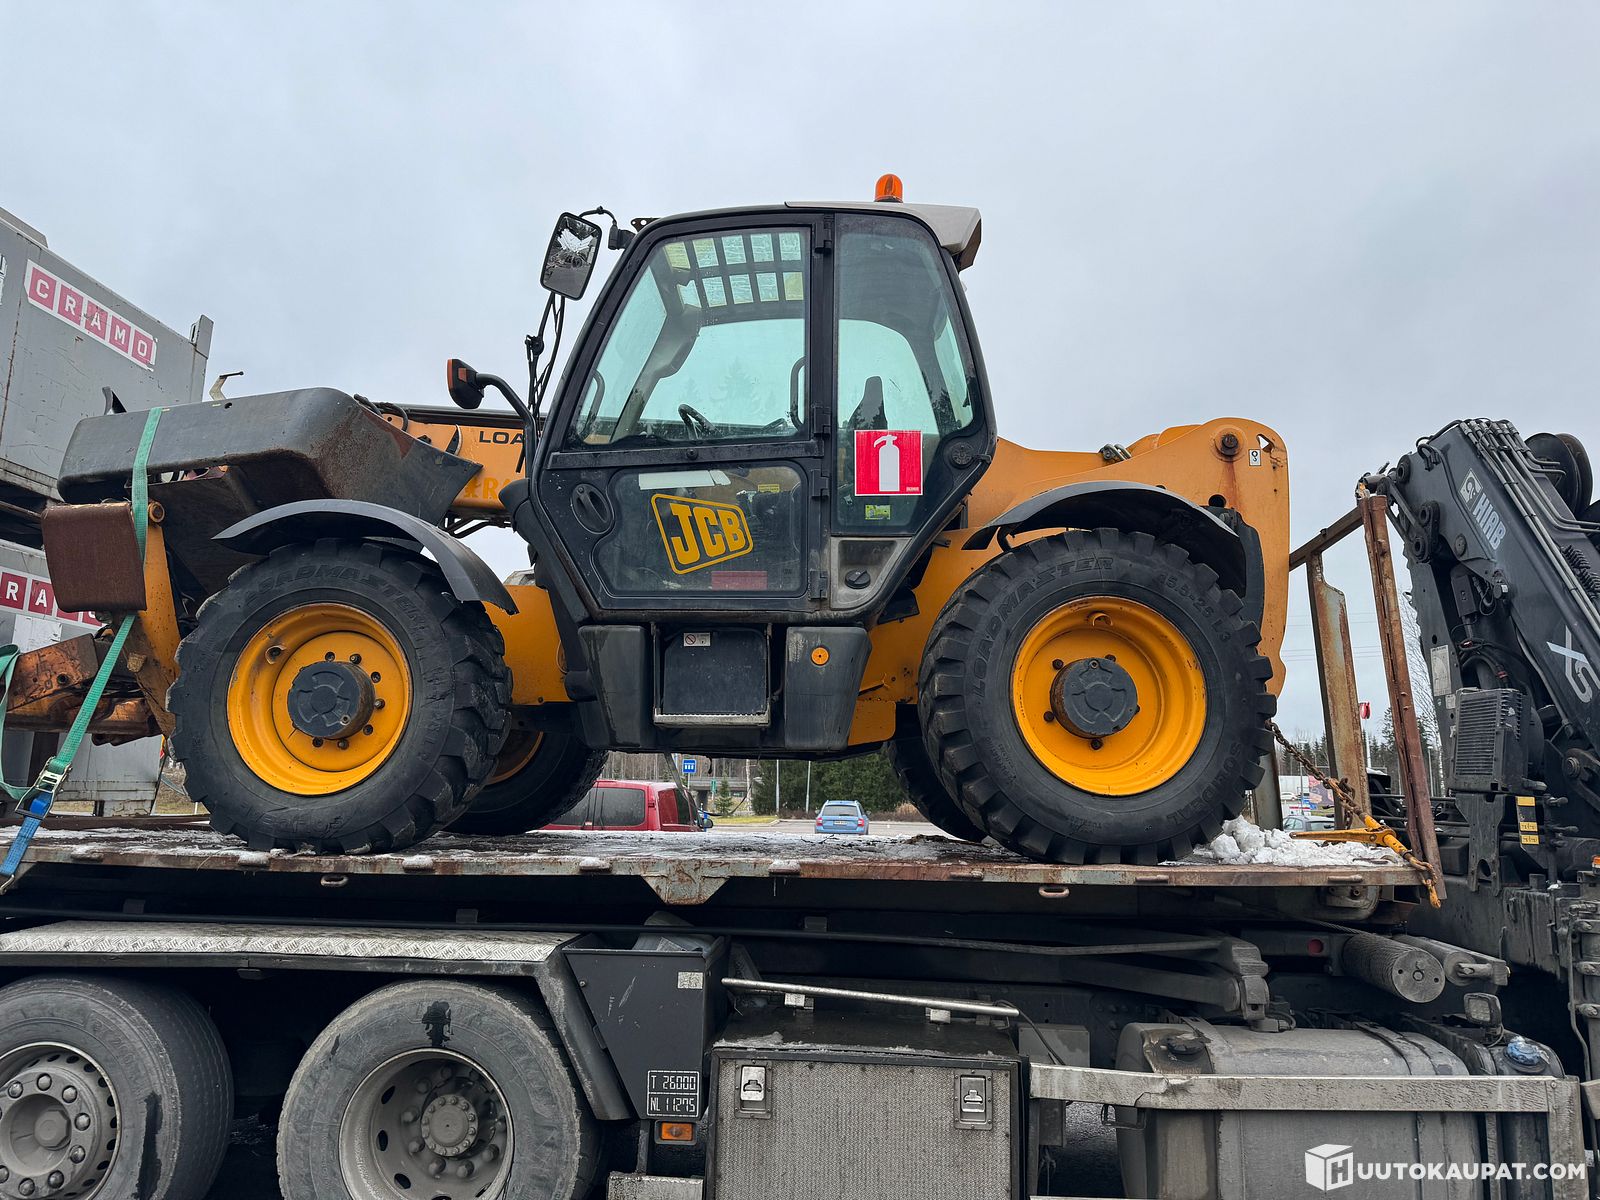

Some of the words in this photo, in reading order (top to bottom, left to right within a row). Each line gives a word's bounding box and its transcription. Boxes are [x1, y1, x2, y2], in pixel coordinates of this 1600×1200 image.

[36, 278, 148, 357] CRAMO
[669, 502, 747, 565] JCB
[1472, 492, 1507, 550] HIAB
[650, 1097, 661, 1112] NL
[651, 1075, 657, 1089] T
[662, 1075, 696, 1091] 26000
